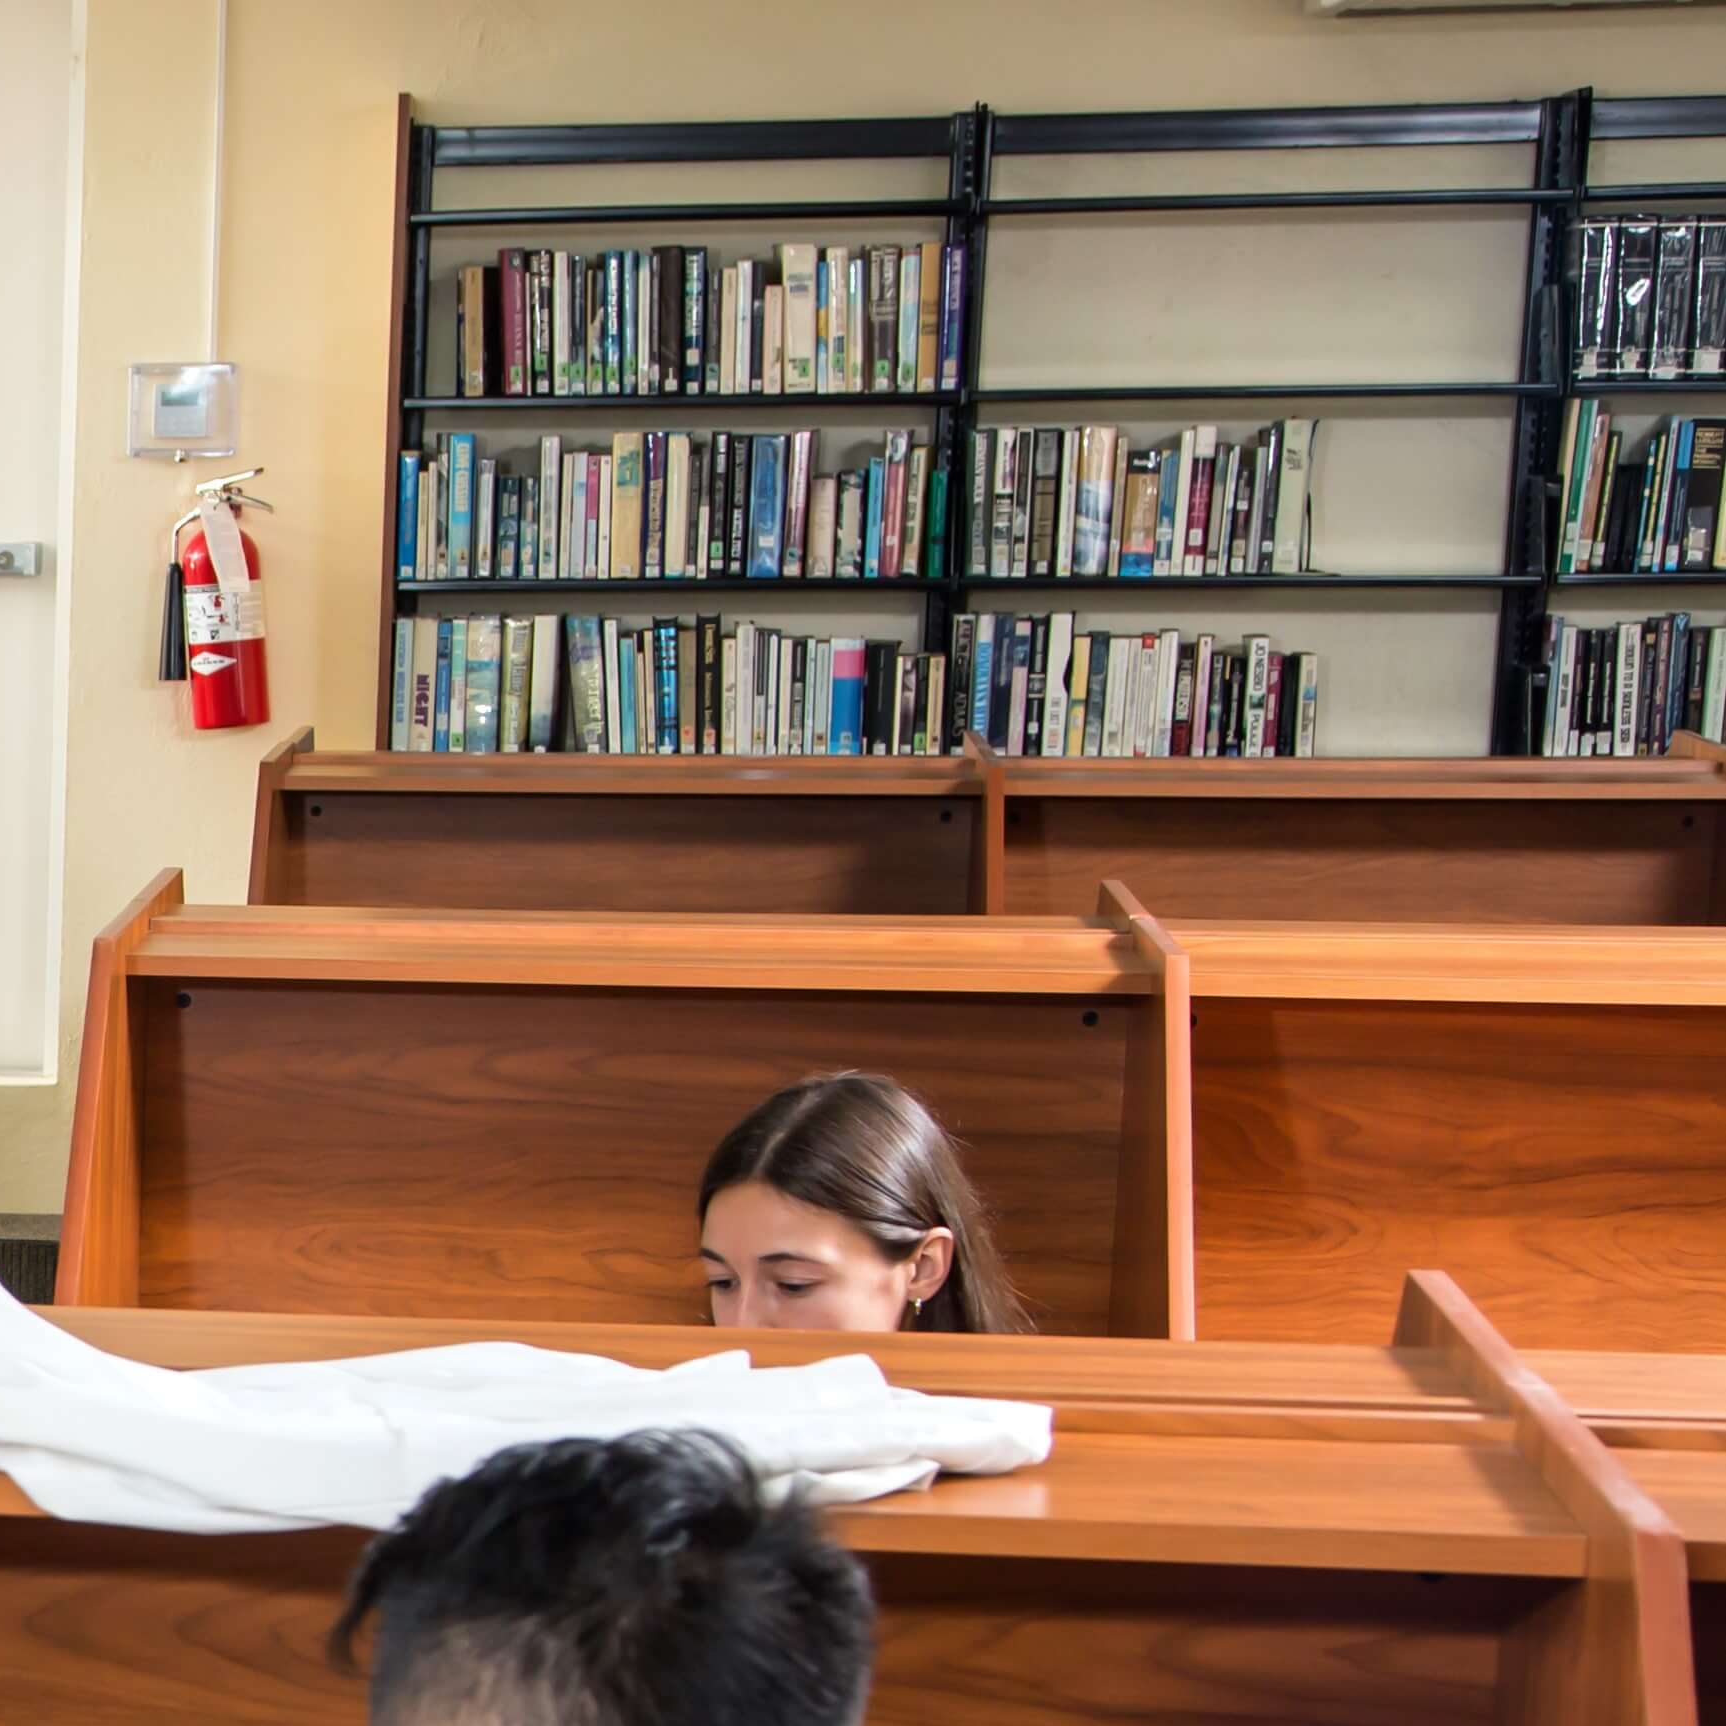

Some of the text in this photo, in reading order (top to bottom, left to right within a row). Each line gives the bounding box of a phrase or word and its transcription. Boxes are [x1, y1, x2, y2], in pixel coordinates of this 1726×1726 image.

[1255, 642, 1266, 656] JO
[415, 673, 430, 727] NIGHT
[952, 691, 966, 737] ADAMS
